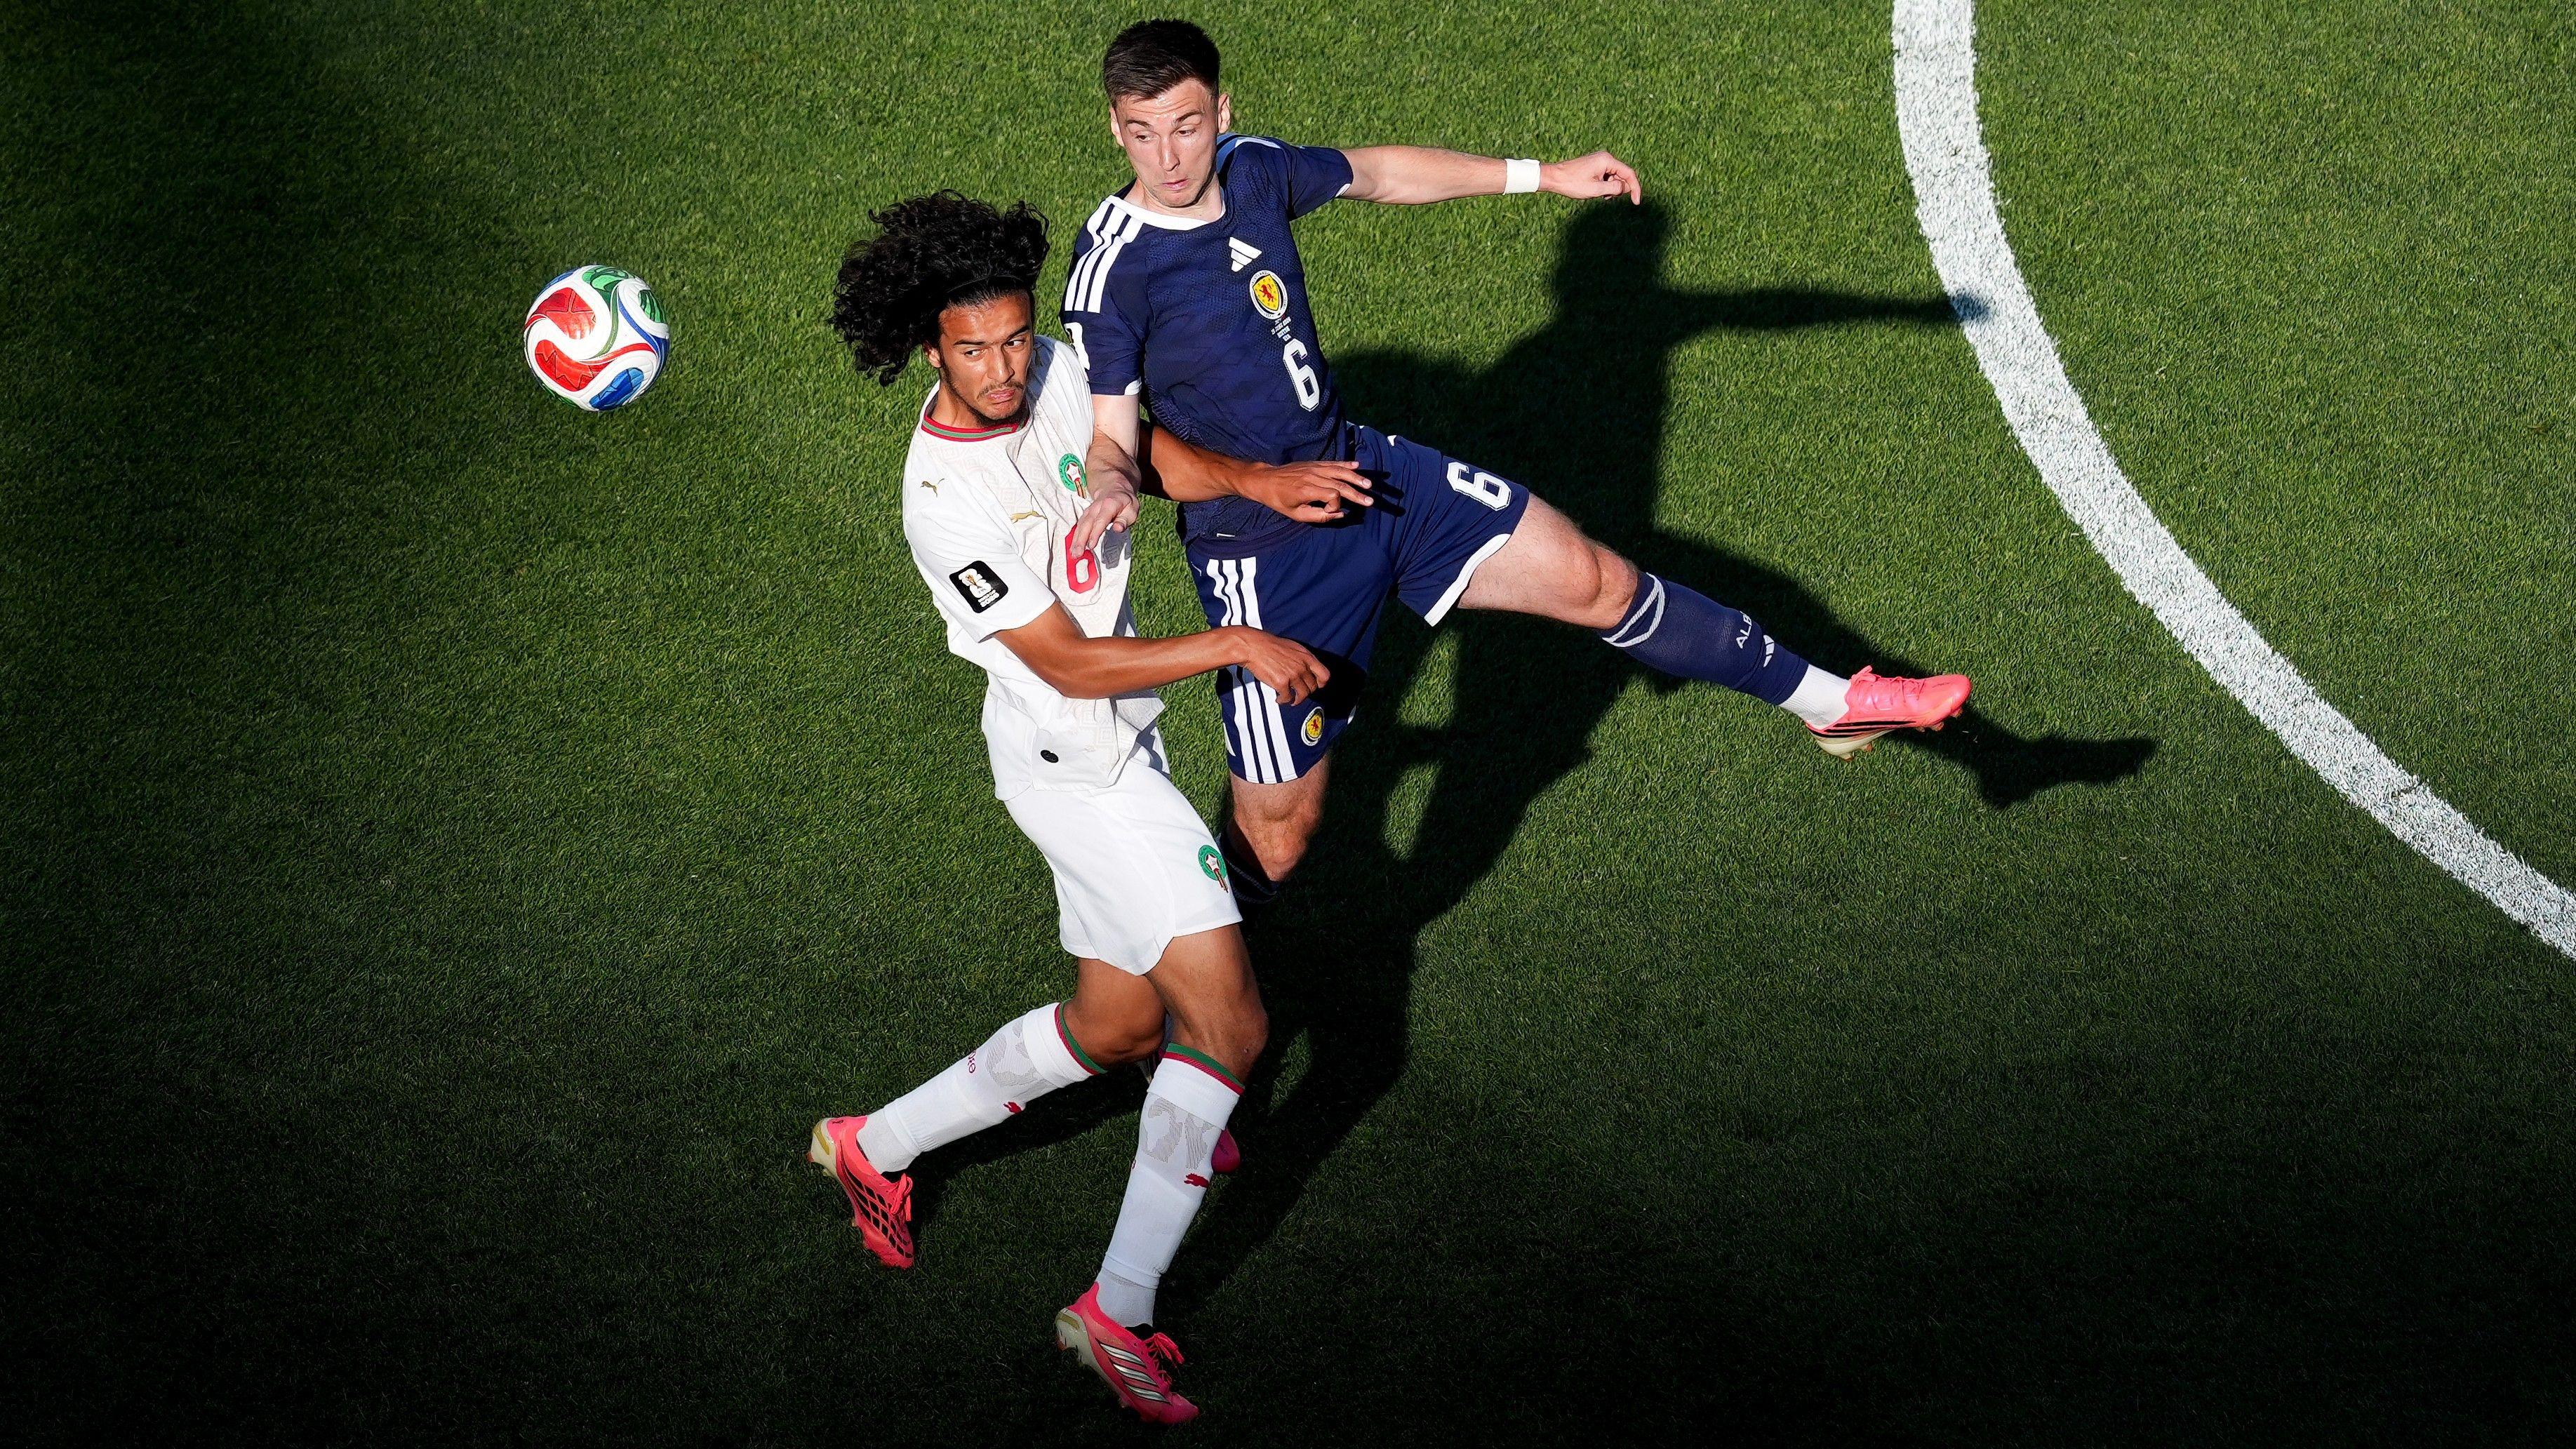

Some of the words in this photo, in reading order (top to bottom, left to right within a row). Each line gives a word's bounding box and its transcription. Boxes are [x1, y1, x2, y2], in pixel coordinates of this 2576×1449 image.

[1283, 338, 1320, 412] 6
[1446, 461, 1511, 512] 6
[1065, 524, 1100, 594] 6
[1735, 610, 1752, 649] ALB
